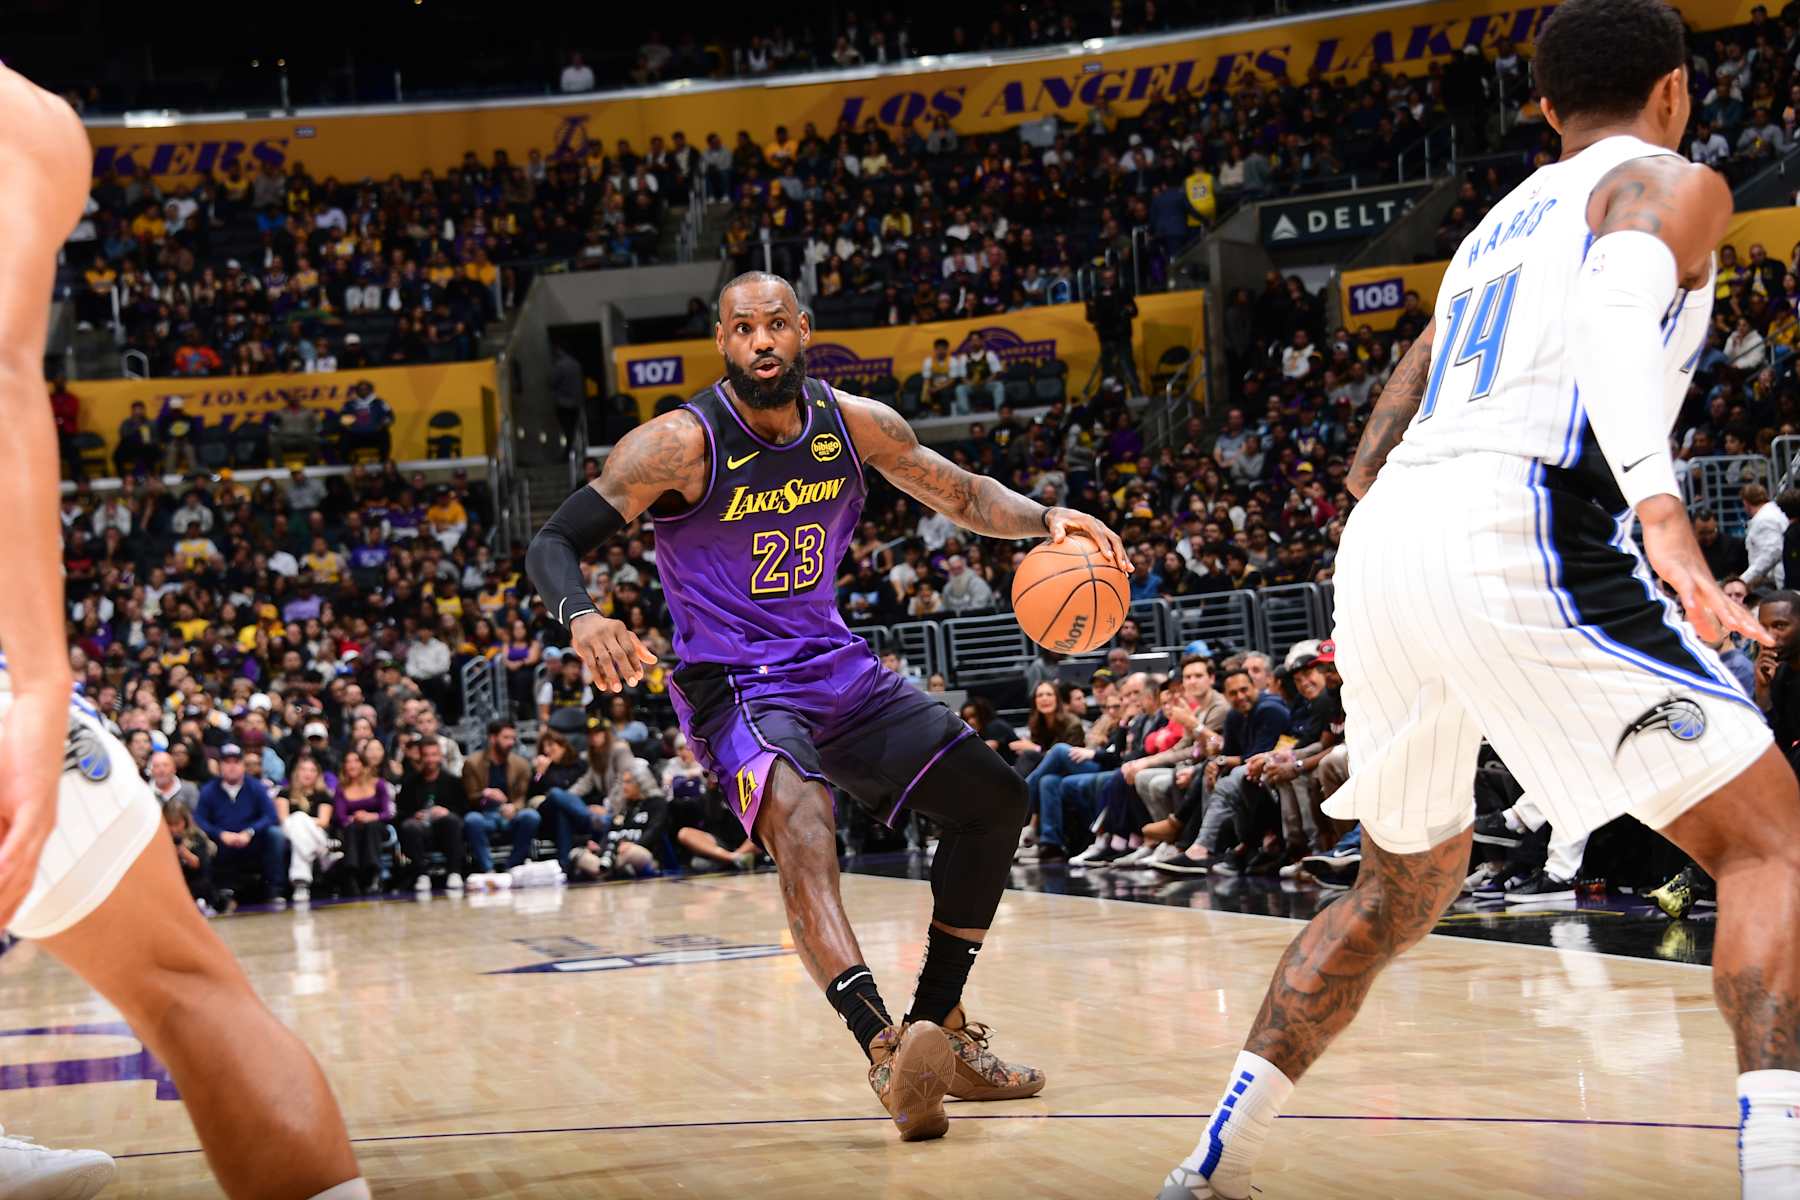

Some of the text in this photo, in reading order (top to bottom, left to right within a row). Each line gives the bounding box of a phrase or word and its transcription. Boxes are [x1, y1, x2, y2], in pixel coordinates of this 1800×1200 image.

[839, 6, 1558, 128] LOS ANGELES LAKER
[92, 138, 290, 177] KERS
[1468, 198, 1558, 269] HARRIS
[1353, 283, 1399, 311] 108
[1417, 263, 1523, 424] 14
[634, 359, 678, 385] 107
[256, 385, 360, 403] ANGELE
[751, 523, 827, 598] 23
[1053, 614, 1089, 651] lson
